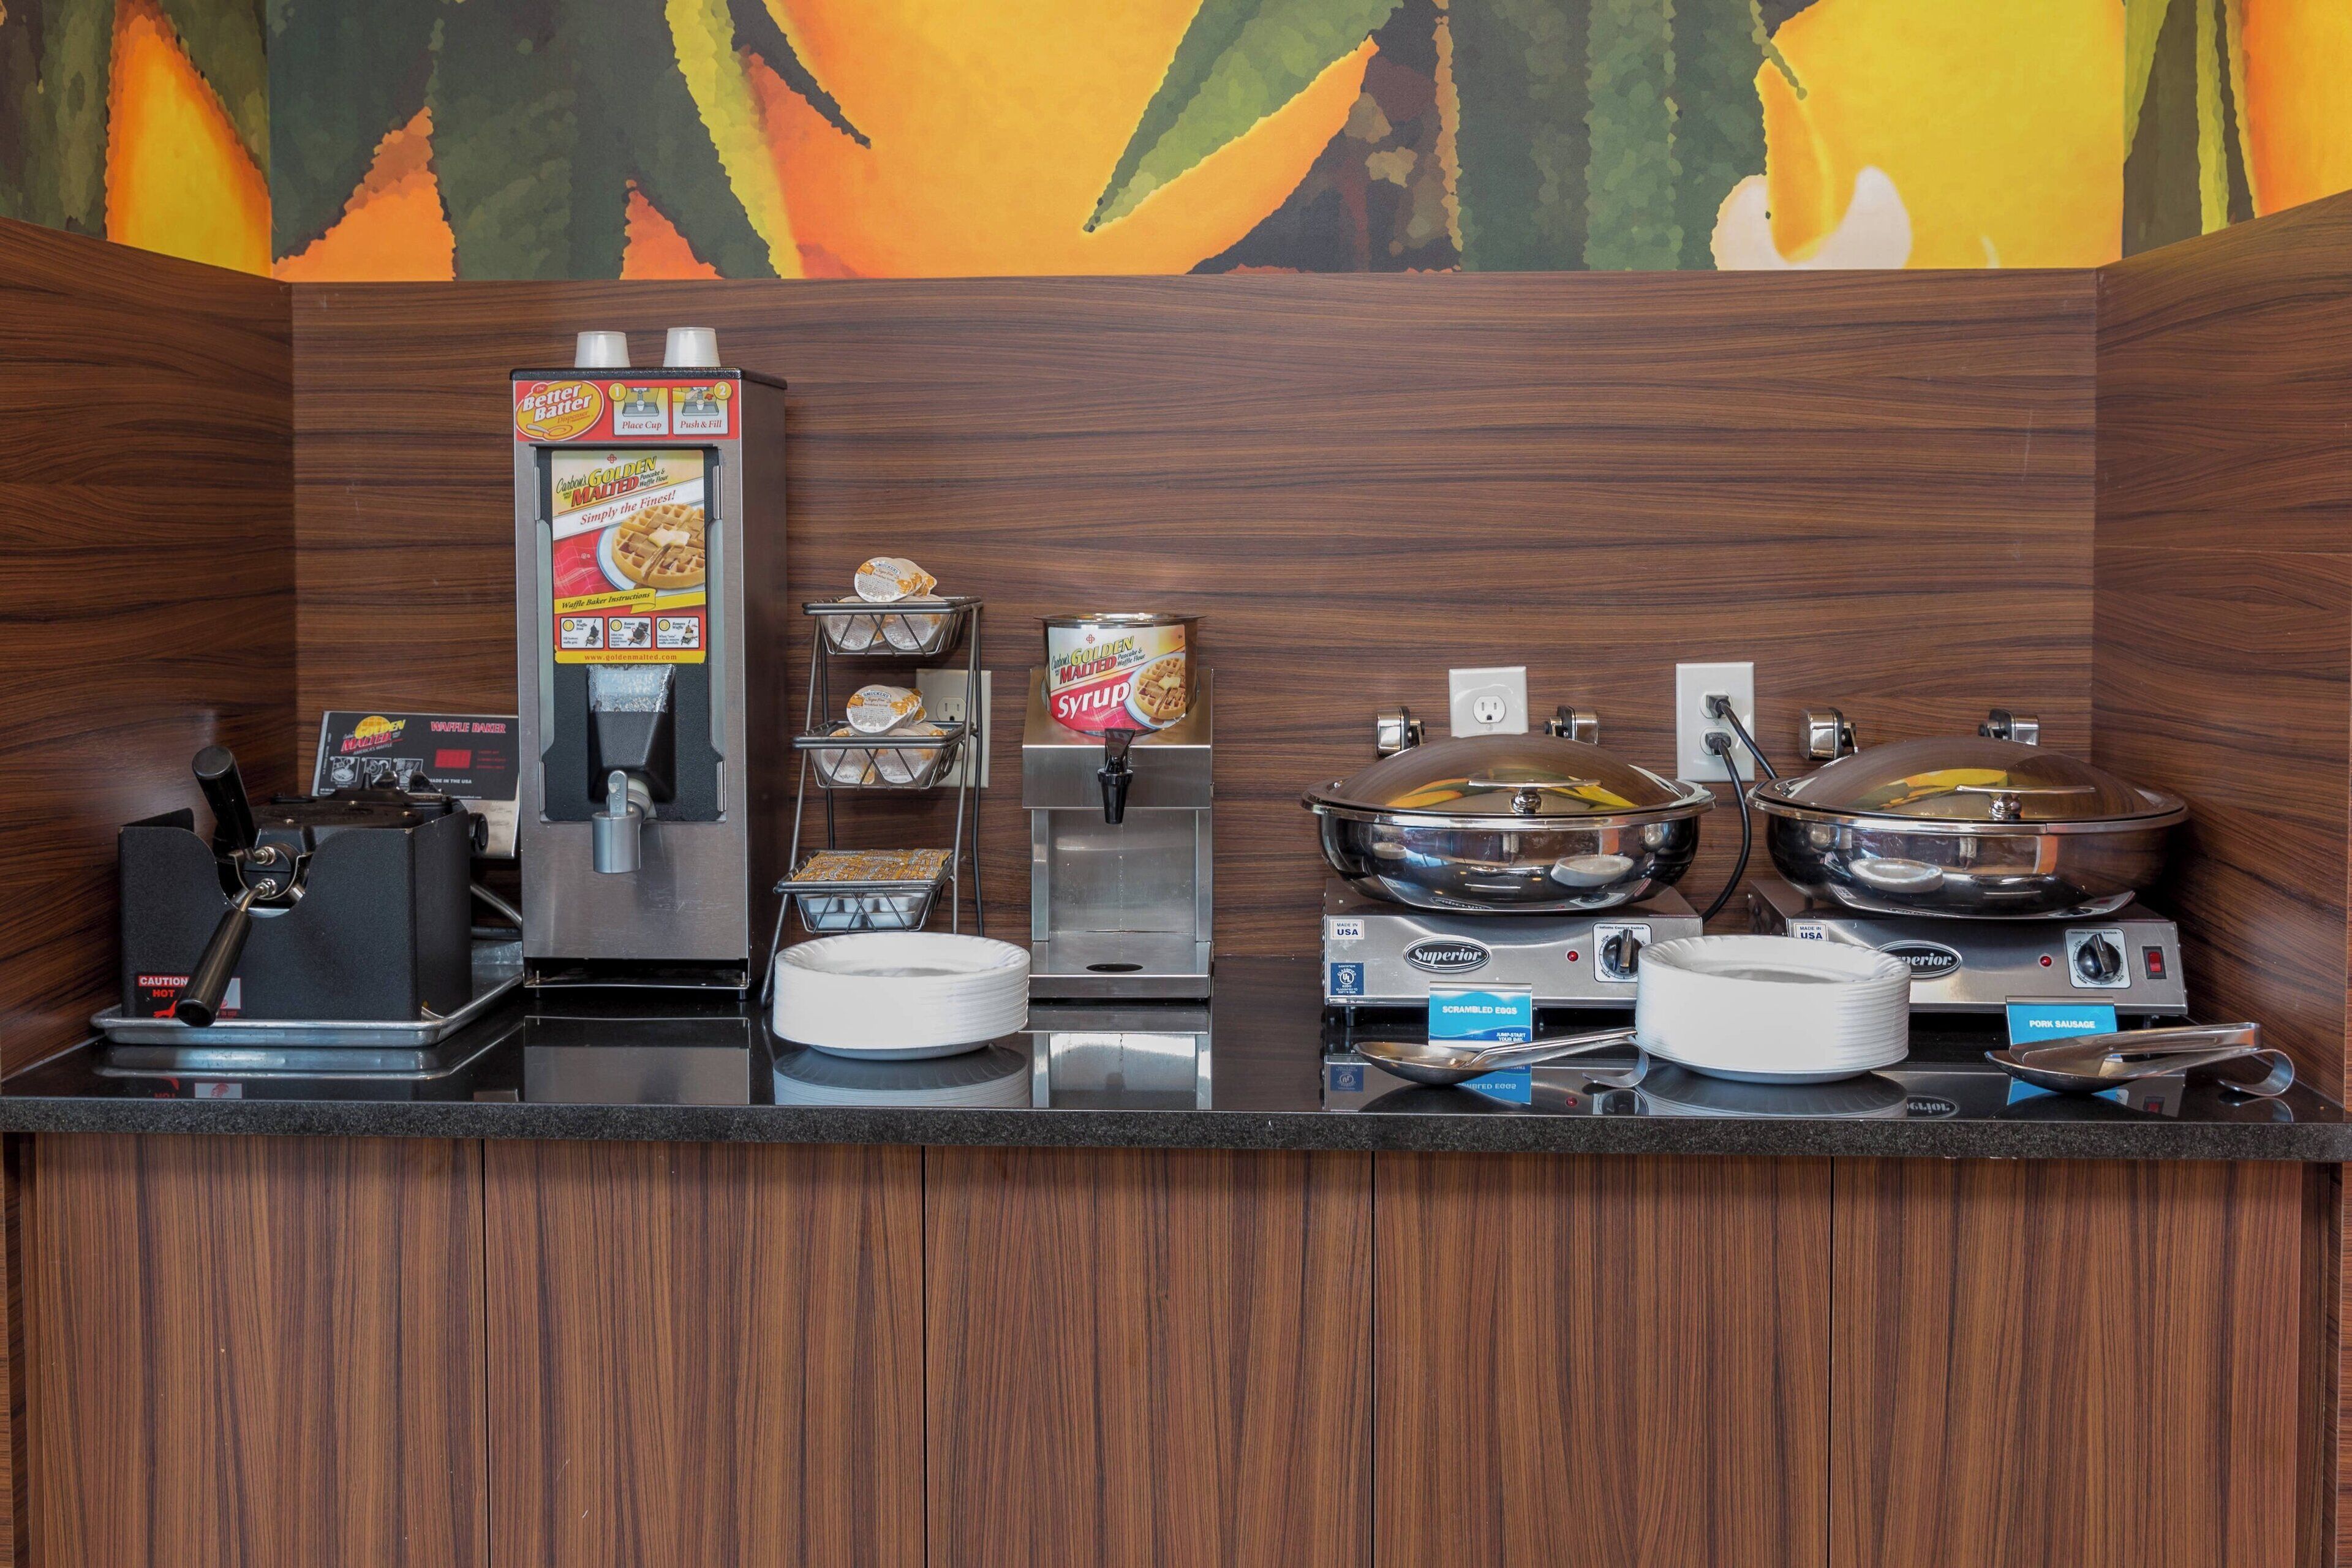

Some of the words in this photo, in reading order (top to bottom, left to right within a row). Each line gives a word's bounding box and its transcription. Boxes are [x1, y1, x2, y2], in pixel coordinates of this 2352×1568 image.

[615, 386, 620, 397] 1
[719, 386, 726, 396] 2
[522, 383, 582, 412] Better
[533, 394, 593, 423] Batter
[557, 411, 589, 423] Dispenser
[622, 421, 643, 429] Place
[645, 421, 662, 431] Cup
[680, 420, 699, 429] Push
[709, 420, 723, 429] Fill
[588, 456, 657, 488] GOLDEN
[640, 470, 660, 480] Pancake
[639, 478, 655, 487] Waffle
[571, 475, 639, 507] MALTED
[580, 507, 618, 525] Simply
[620, 500, 637, 514] the
[640, 489, 676, 508] Finest!
[562, 600, 585, 609] Waffle
[586, 597, 607, 606] Baker
[608, 592, 650, 603] Instructions
[584, 652, 677, 661] www.goldenmalted.com
[1071, 635, 1134, 666] GOLDEN
[1118, 650, 1137, 660] Pancake
[1117, 658, 1133, 667] Waffle
[1060, 656, 1117, 684] MALTED
[1058, 681, 1131, 719] Syrup
[360, 719, 406, 736] GOLDEN
[431, 721, 469, 733] WAFFLE
[472, 722, 506, 733] BAKER
[341, 732, 391, 752] MALTED
[1414, 948, 1482, 965] Superior
[1899, 952, 1952, 965] perior
[140, 977, 189, 986] CAUTION
[1343, 973, 1351, 982] UL
[153, 989, 175, 998] HOT
[1495, 1006, 1517, 1015] EGGS
